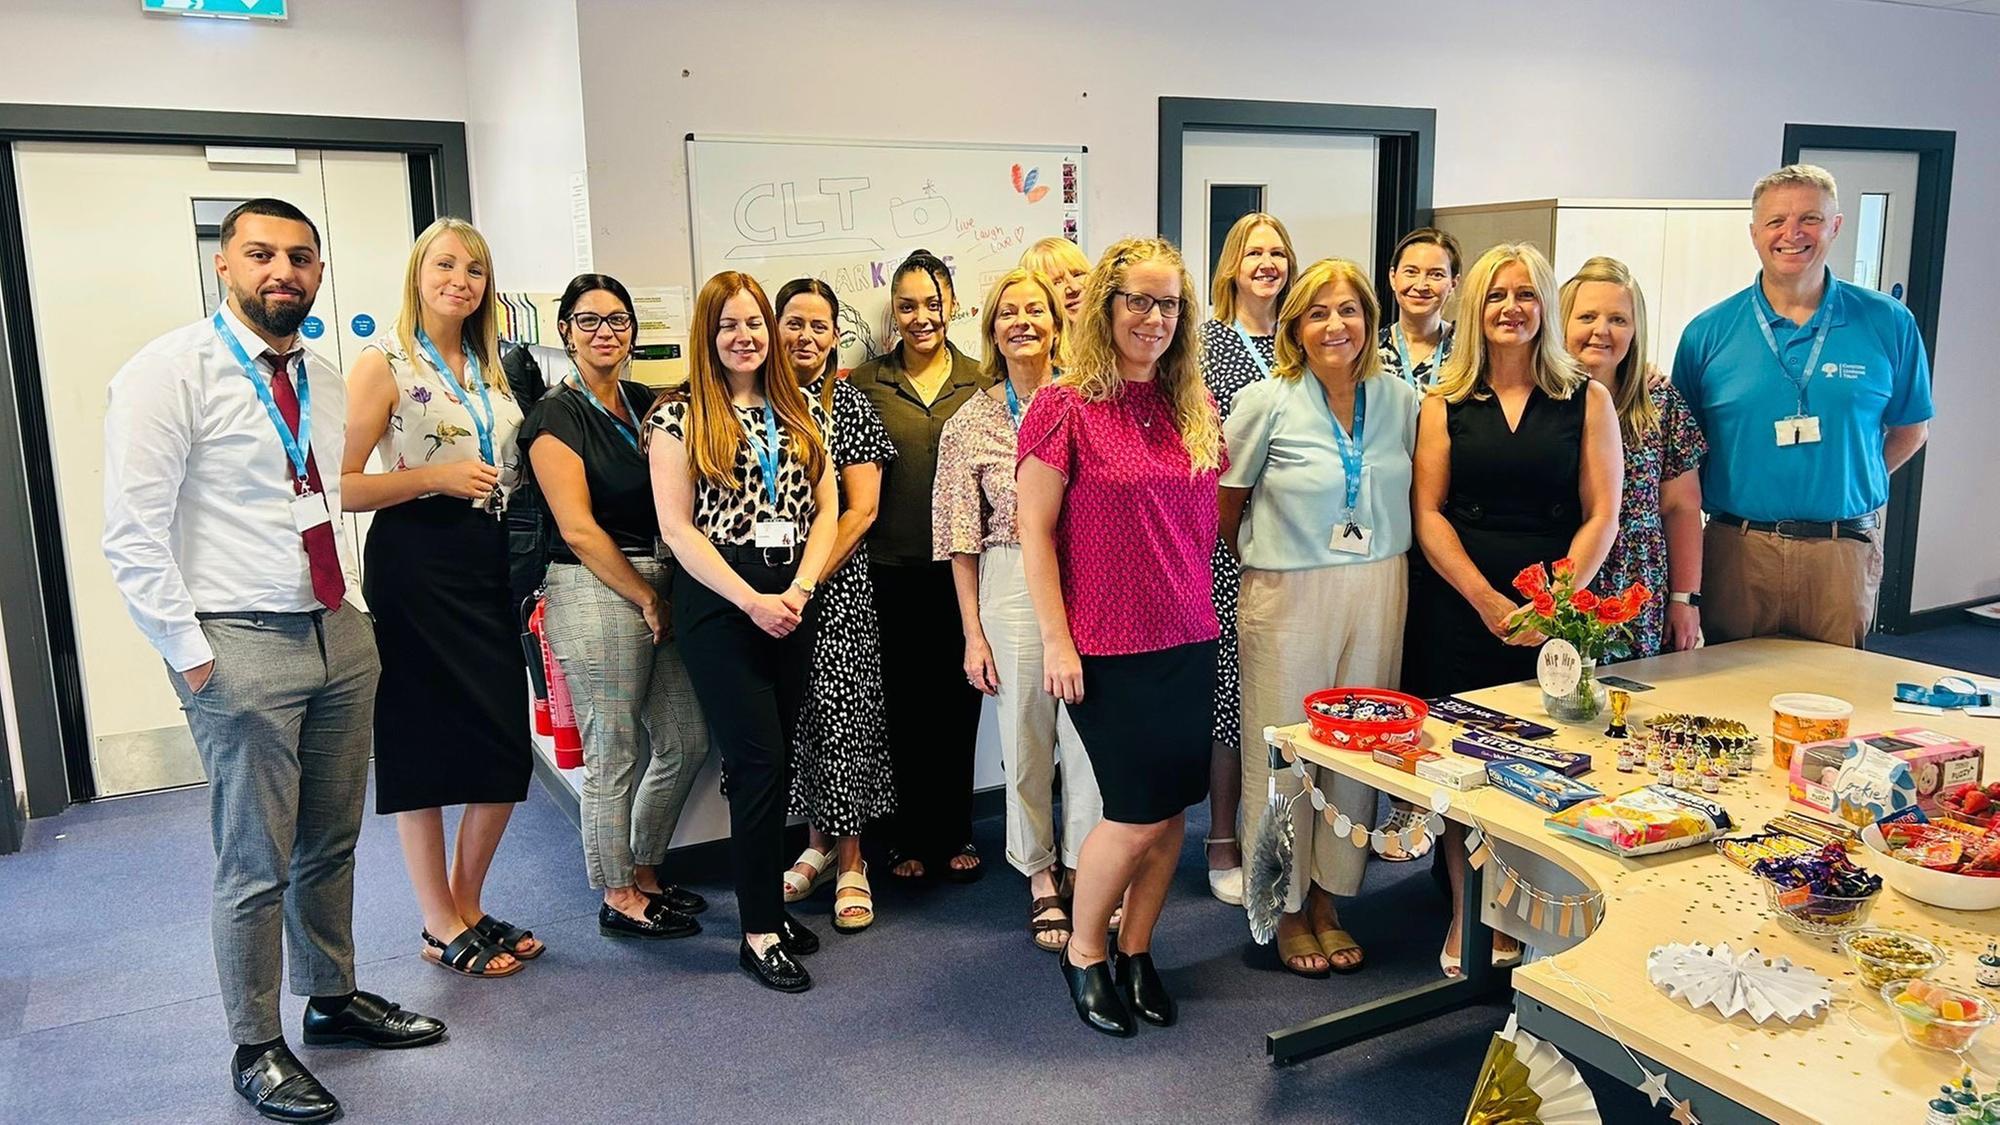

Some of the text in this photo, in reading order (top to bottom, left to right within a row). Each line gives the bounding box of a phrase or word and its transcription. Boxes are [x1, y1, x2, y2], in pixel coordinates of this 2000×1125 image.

[733, 176, 870, 243] CLT
[1447, 699, 1497, 719] THANK
[1477, 734, 1556, 760] fingers
